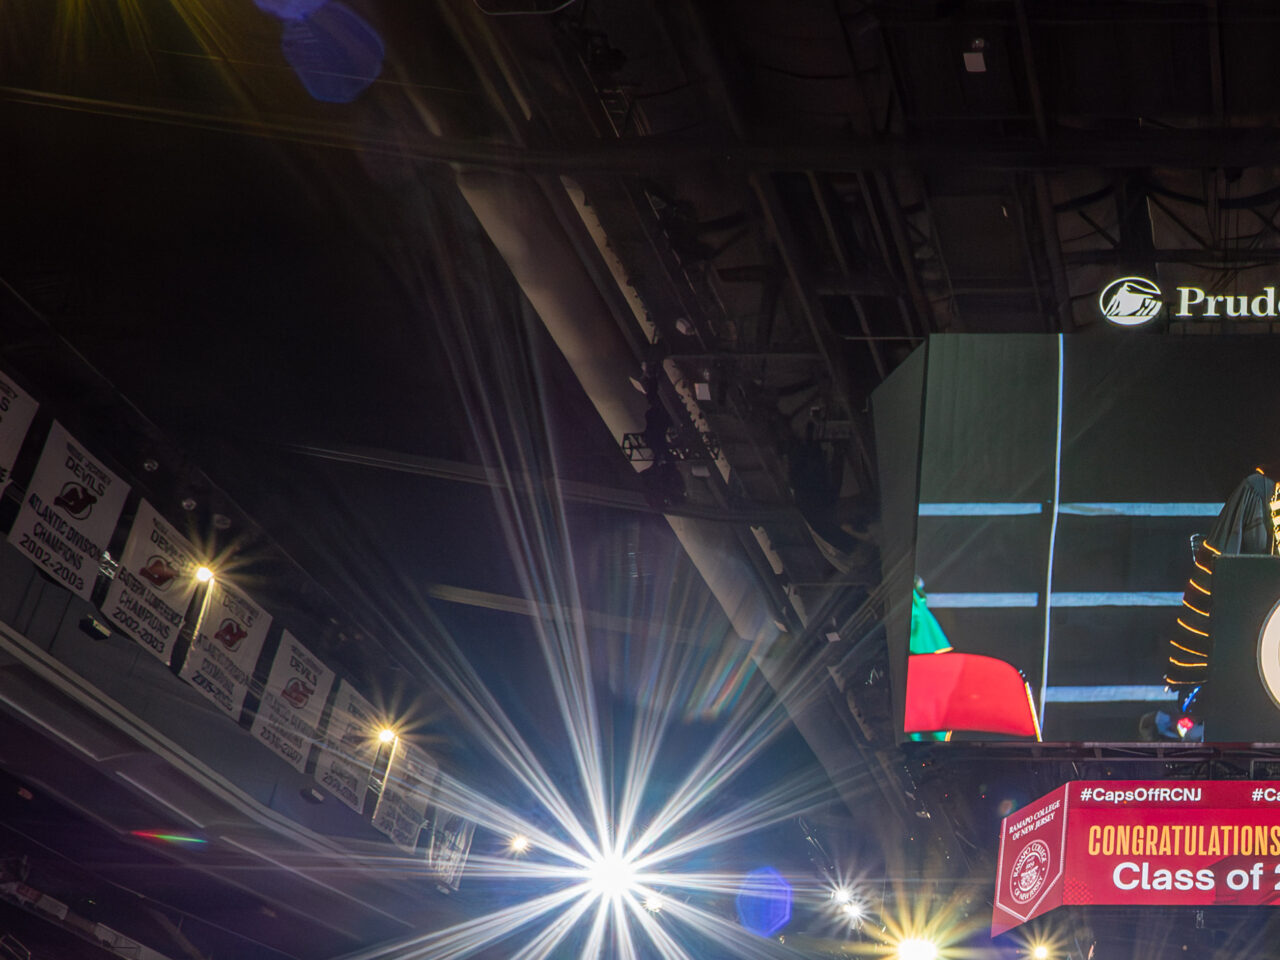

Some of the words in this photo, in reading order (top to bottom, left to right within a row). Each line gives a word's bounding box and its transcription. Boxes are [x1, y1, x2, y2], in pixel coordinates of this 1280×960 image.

[65, 455, 107, 498] DEVILS
[28, 492, 68, 536] ATLANTIC
[19, 532, 85, 591] 2002-2003
[33, 521, 85, 571] CHAMPIONS
[120, 590, 171, 640] CHAMPIONS
[1009, 815, 1034, 834] RAMAPO
[1033, 800, 1061, 821] COLLEGE
[1080, 788, 1202, 804] #CapsOffRCNJ
[1012, 831, 1021, 841] OF
[1020, 823, 1036, 837] NEW
[1034, 812, 1055, 831] JERSEY
[1112, 862, 1215, 891] Class
[1226, 862, 1264, 891] of
